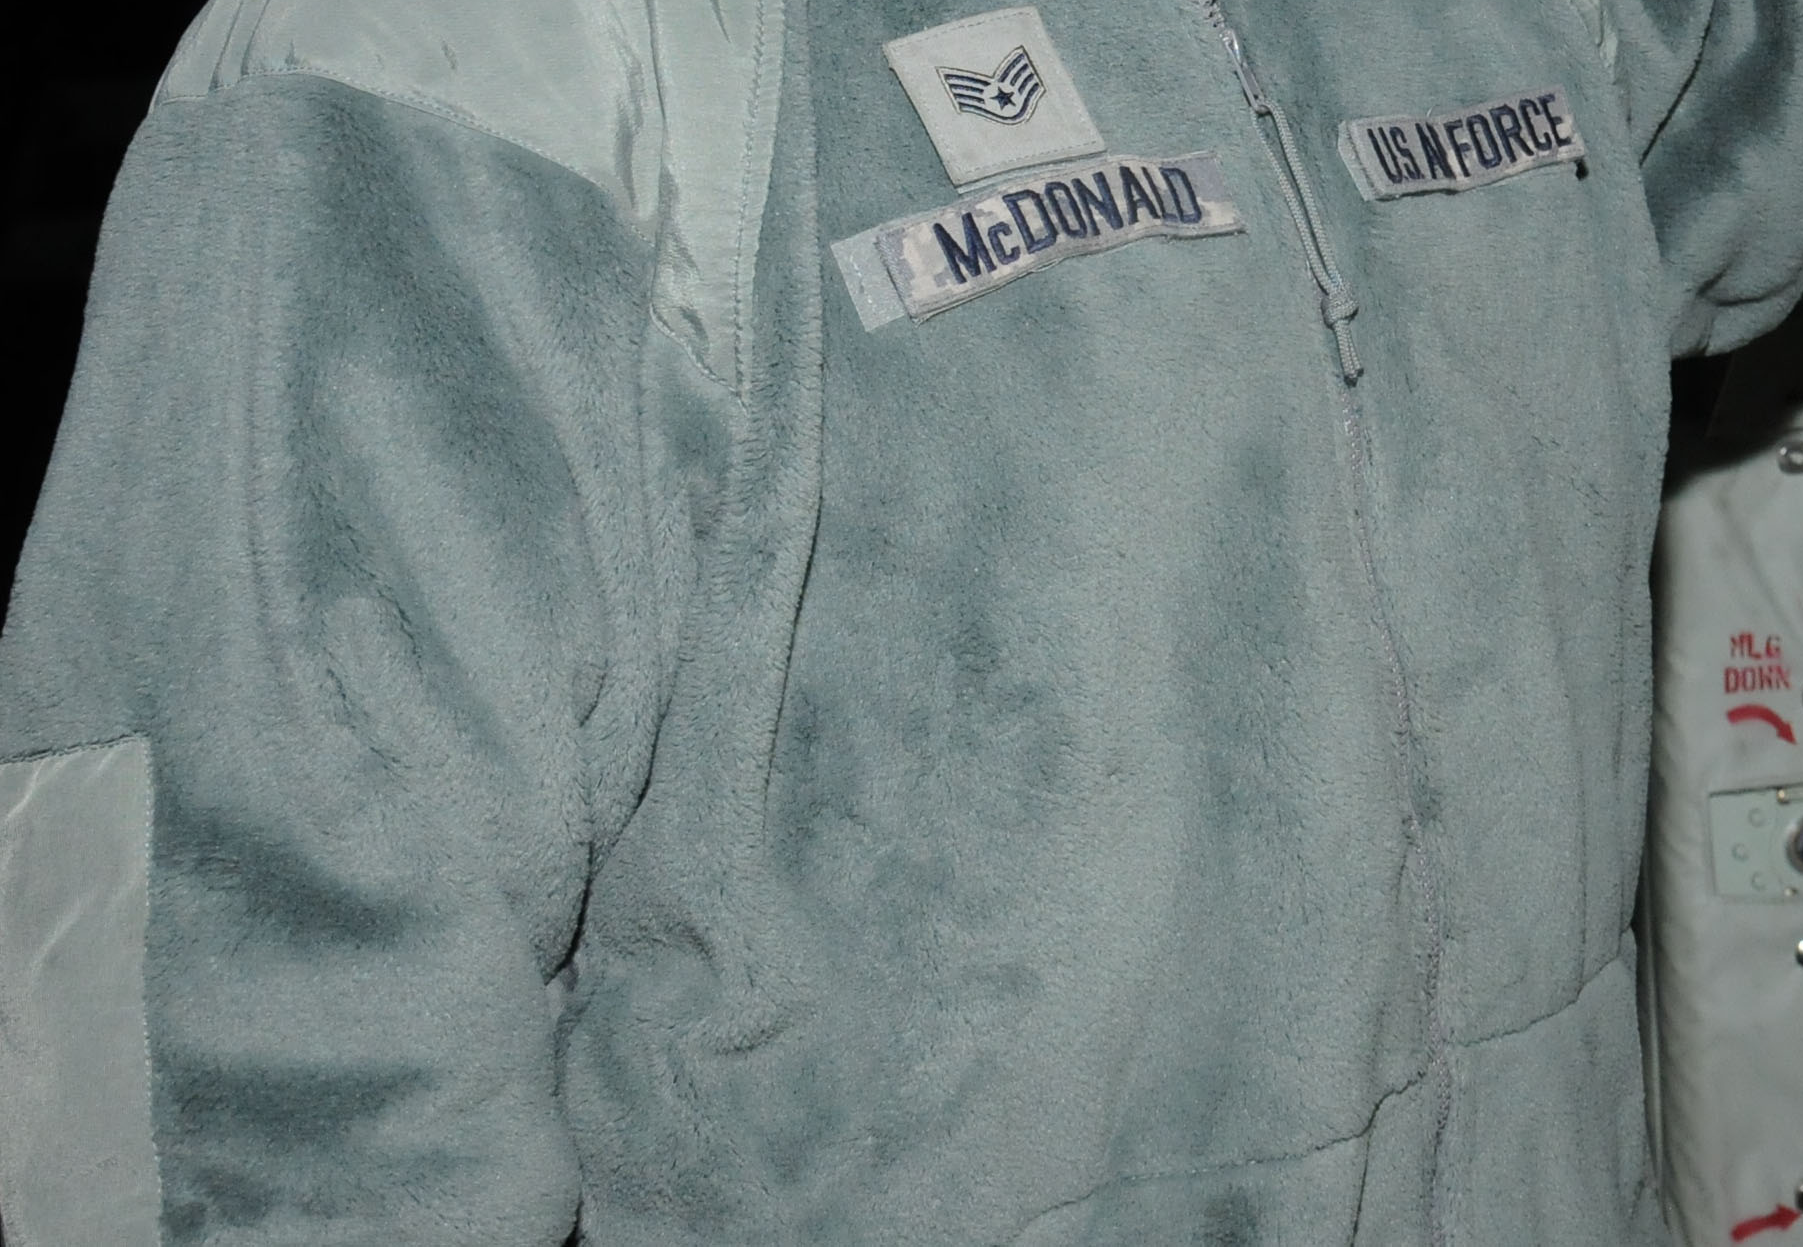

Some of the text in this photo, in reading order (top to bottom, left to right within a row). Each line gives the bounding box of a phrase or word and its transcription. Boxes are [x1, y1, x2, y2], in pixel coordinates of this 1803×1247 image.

[1443, 93, 1573, 178] FORCE
[932, 165, 1203, 285] McDONALD
[1730, 631, 1782, 660] MLG
[1724, 665, 1791, 693] DOWN
